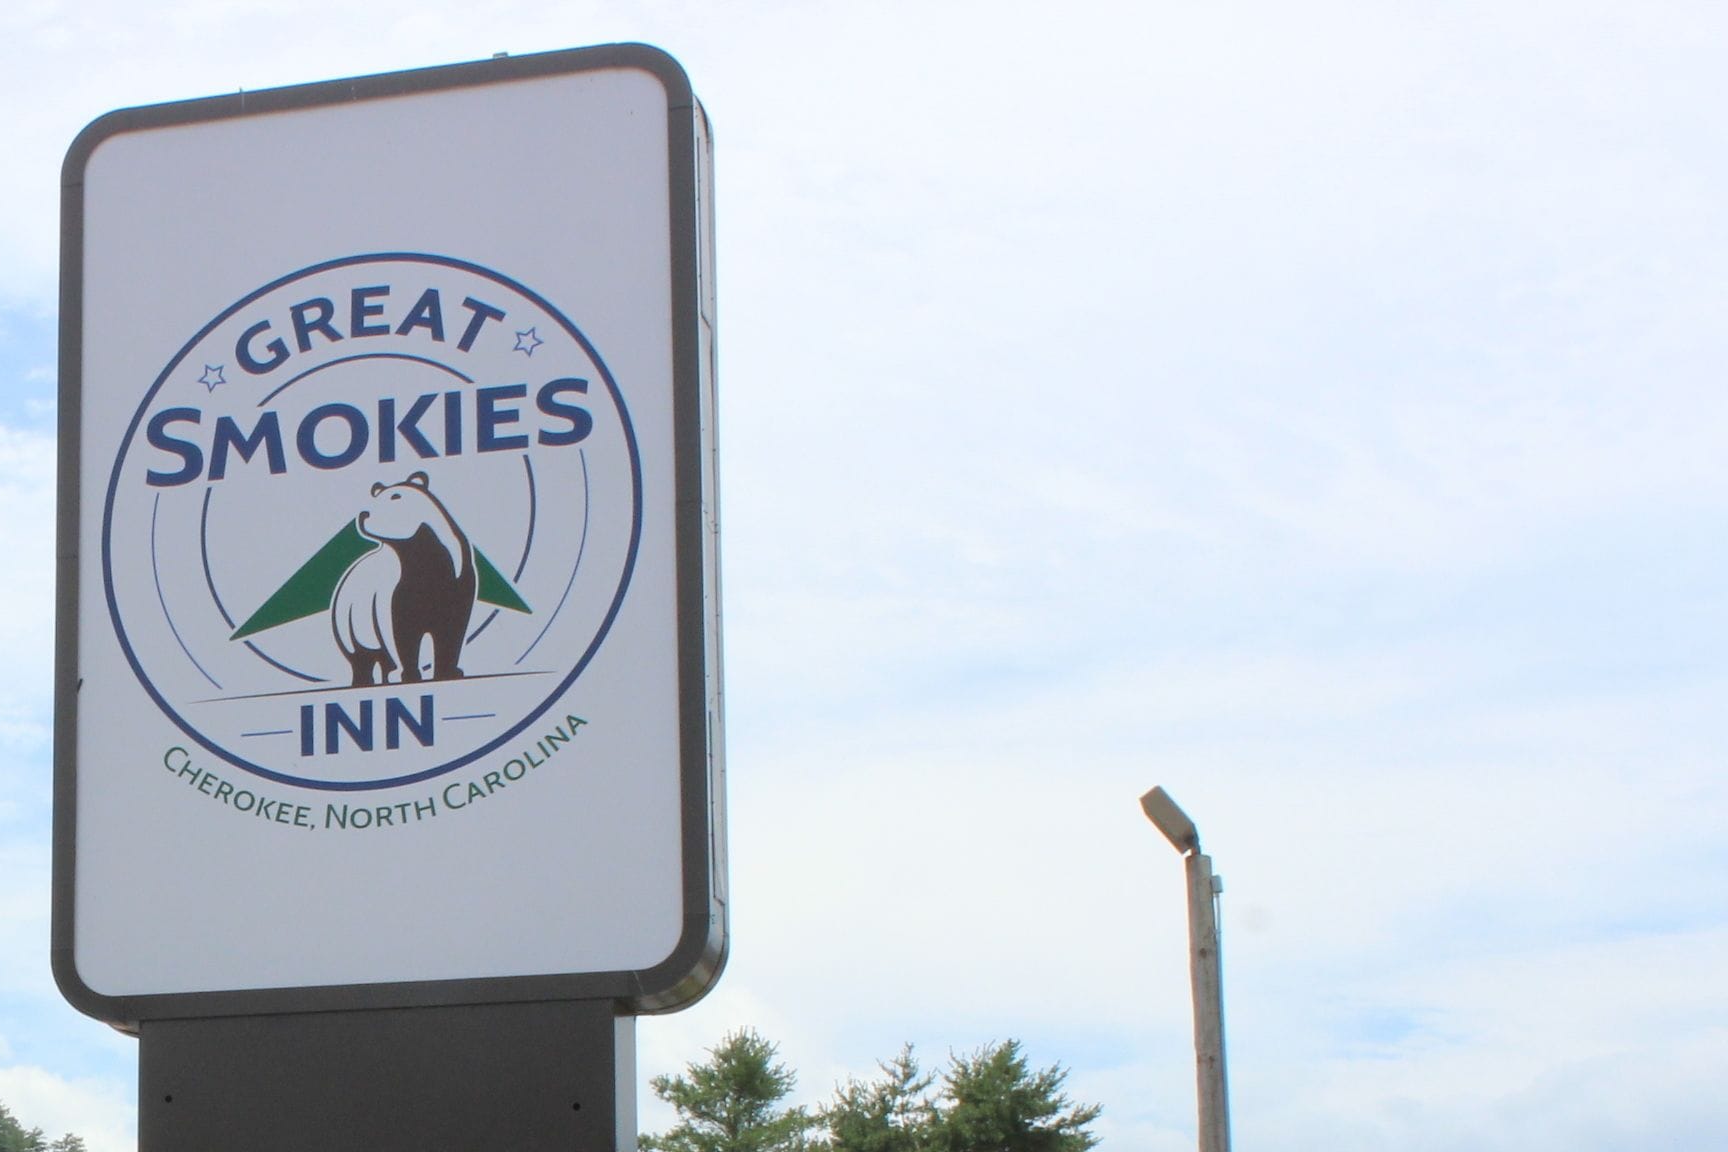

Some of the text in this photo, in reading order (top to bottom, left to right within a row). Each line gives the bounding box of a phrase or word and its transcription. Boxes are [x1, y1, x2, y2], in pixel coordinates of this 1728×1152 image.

[234, 285, 507, 375] GREAT
[145, 377, 594, 487] SMOKIES
[163, 713, 588, 831] CHEROKEE, NORTH CAROLINA
[300, 694, 435, 757] INN
